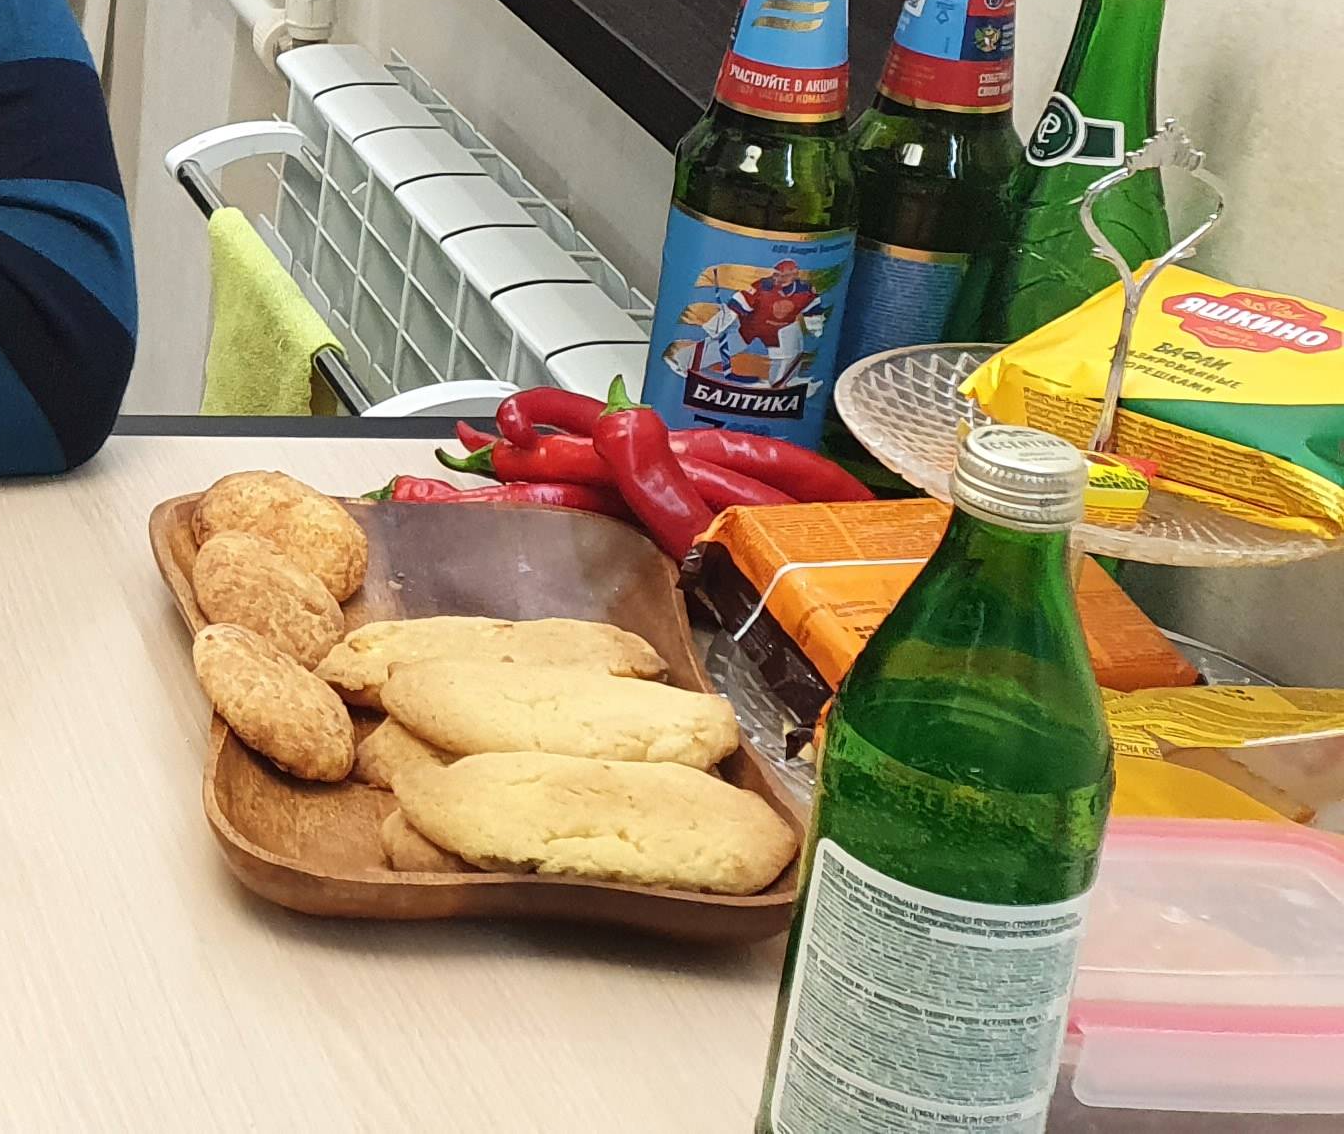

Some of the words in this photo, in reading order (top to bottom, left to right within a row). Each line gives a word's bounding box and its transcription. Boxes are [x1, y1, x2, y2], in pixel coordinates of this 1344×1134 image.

[729, 64, 791, 92] УЧАСТВУЙТЕ
[794, 79, 802, 92] В
[1173, 296, 1329, 347] ЯШКИНО
[1152, 341, 1233, 371] ВАФЛИ
[693, 384, 800, 412] БАЛТИКА
